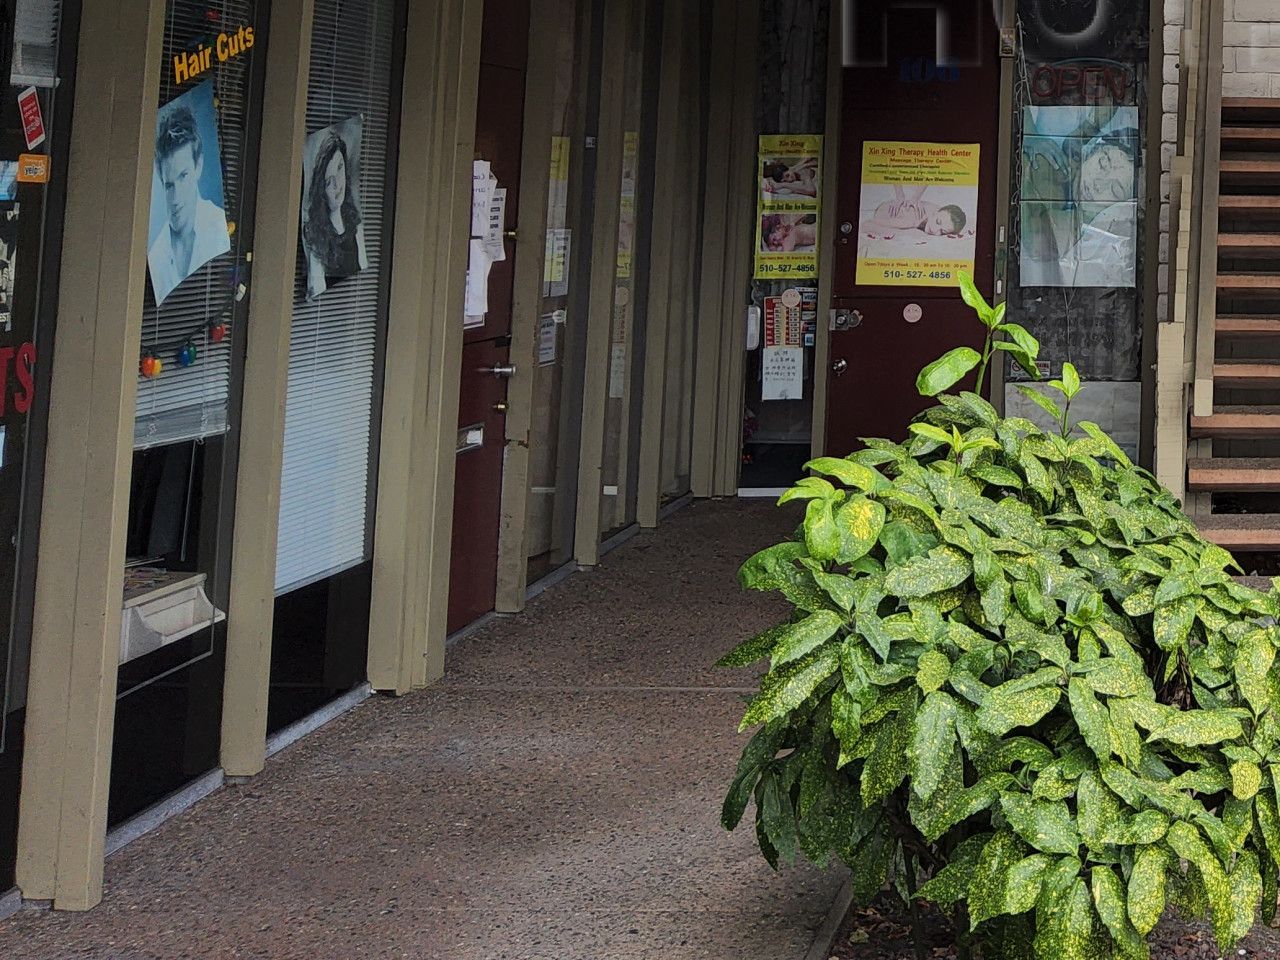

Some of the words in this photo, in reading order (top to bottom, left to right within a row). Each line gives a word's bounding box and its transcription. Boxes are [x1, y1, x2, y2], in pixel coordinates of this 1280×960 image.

[174, 44, 212, 84] Hair
[216, 25, 254, 62] Cuts
[1032, 65, 1127, 100] OPEN
[899, 147, 924, 157] Therapy
[927, 149, 948, 157] Health
[950, 149, 971, 157] Center
[929, 271, 951, 279] 4856
